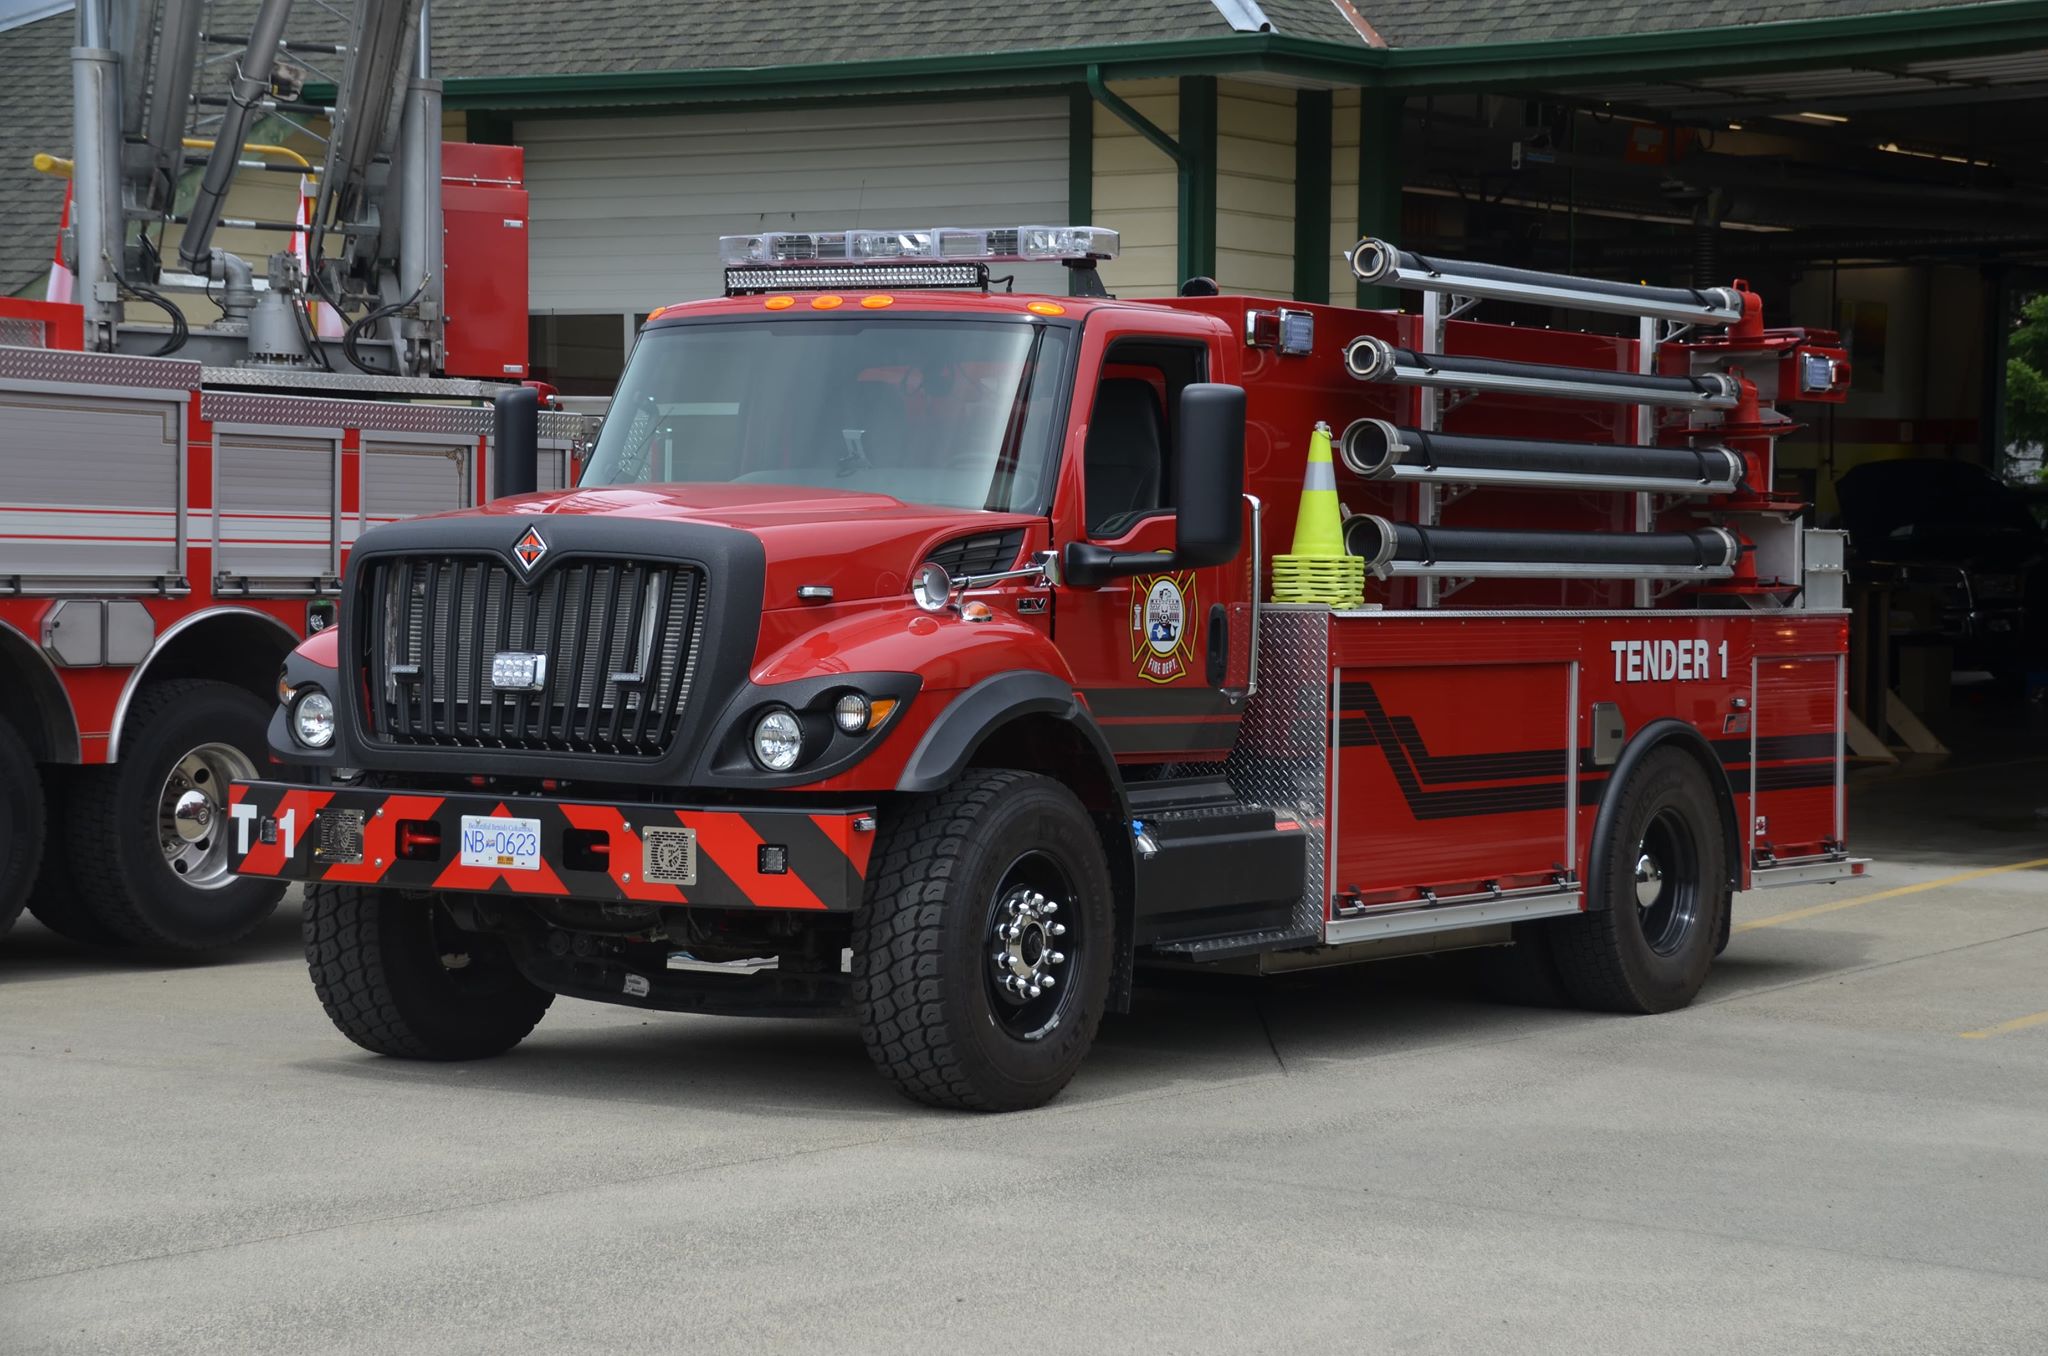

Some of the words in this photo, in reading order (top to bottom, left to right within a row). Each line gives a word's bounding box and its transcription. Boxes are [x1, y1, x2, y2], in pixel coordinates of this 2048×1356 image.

[1148, 658, 1161, 674] FIRE
[1611, 640, 1709, 681] TENDER
[1718, 640, 1728, 679] 1
[231, 803, 257, 854] T
[279, 808, 295, 858] 1
[464, 830, 485, 853] NB
[496, 832, 536, 856] 0623
